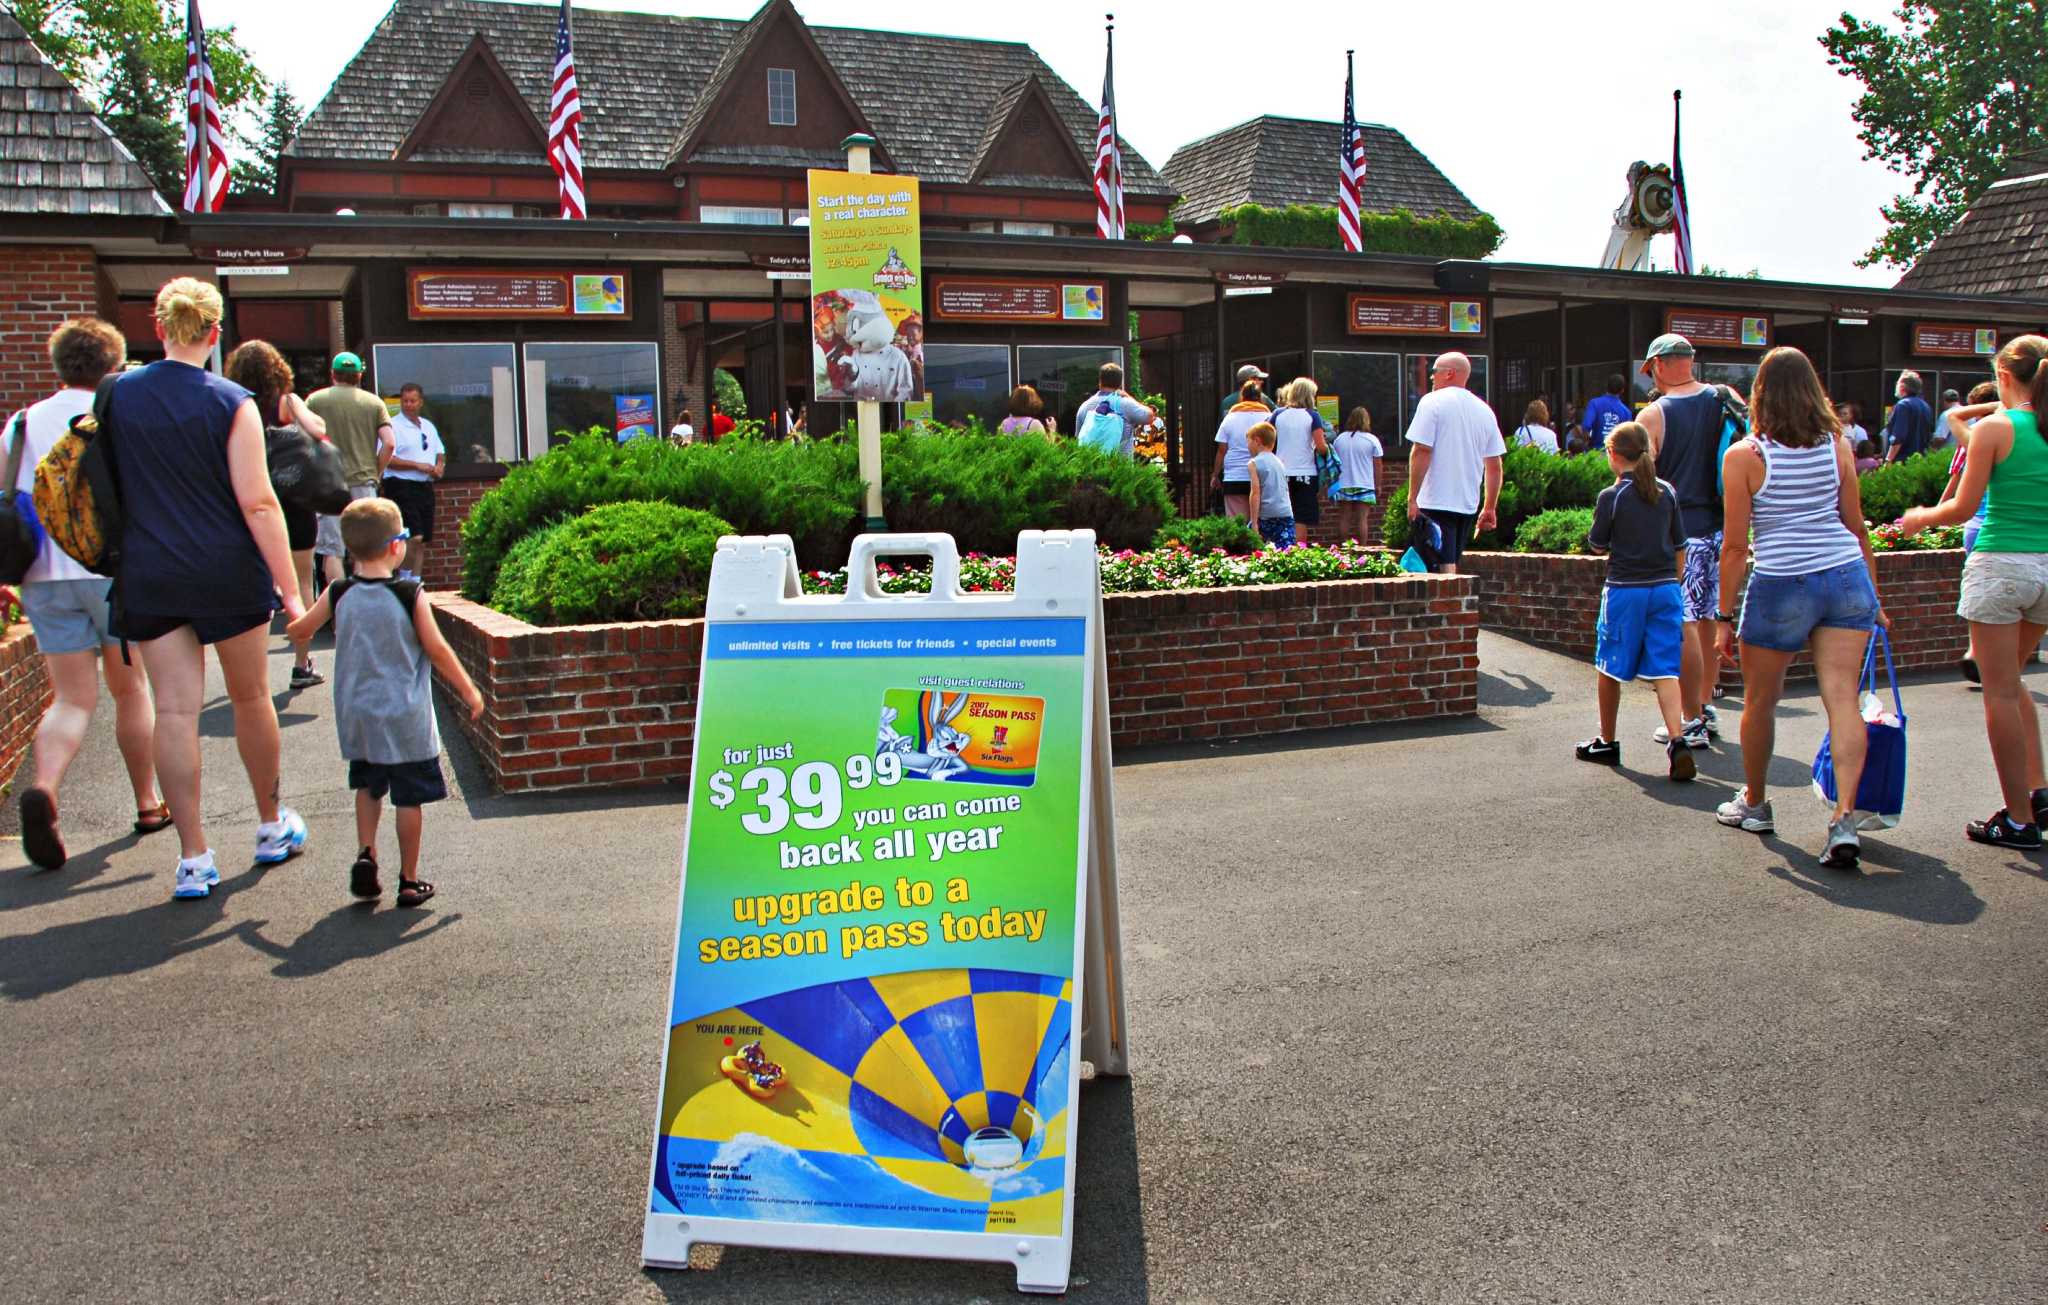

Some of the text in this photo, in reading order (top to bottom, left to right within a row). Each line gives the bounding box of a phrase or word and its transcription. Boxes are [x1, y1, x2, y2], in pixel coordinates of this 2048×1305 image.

[818, 192, 912, 208] Start the day with
[824, 206, 908, 220] a real character.
[216, 250, 242, 258] Today's
[728, 640, 811, 651] unlimited visits
[832, 638, 955, 650] free tickets for friends
[976, 637, 1057, 650] special events
[919, 676, 1025, 690] visit guest relations
[969, 708, 1036, 721] SEASON PASS
[723, 742, 794, 766] for just
[853, 794, 1022, 832] you can come
[779, 824, 1004, 869] back all year
[733, 876, 970, 927] upgrade to a
[698, 906, 1048, 964] season pass today
[696, 1023, 764, 1036] YOU ARE HERE
